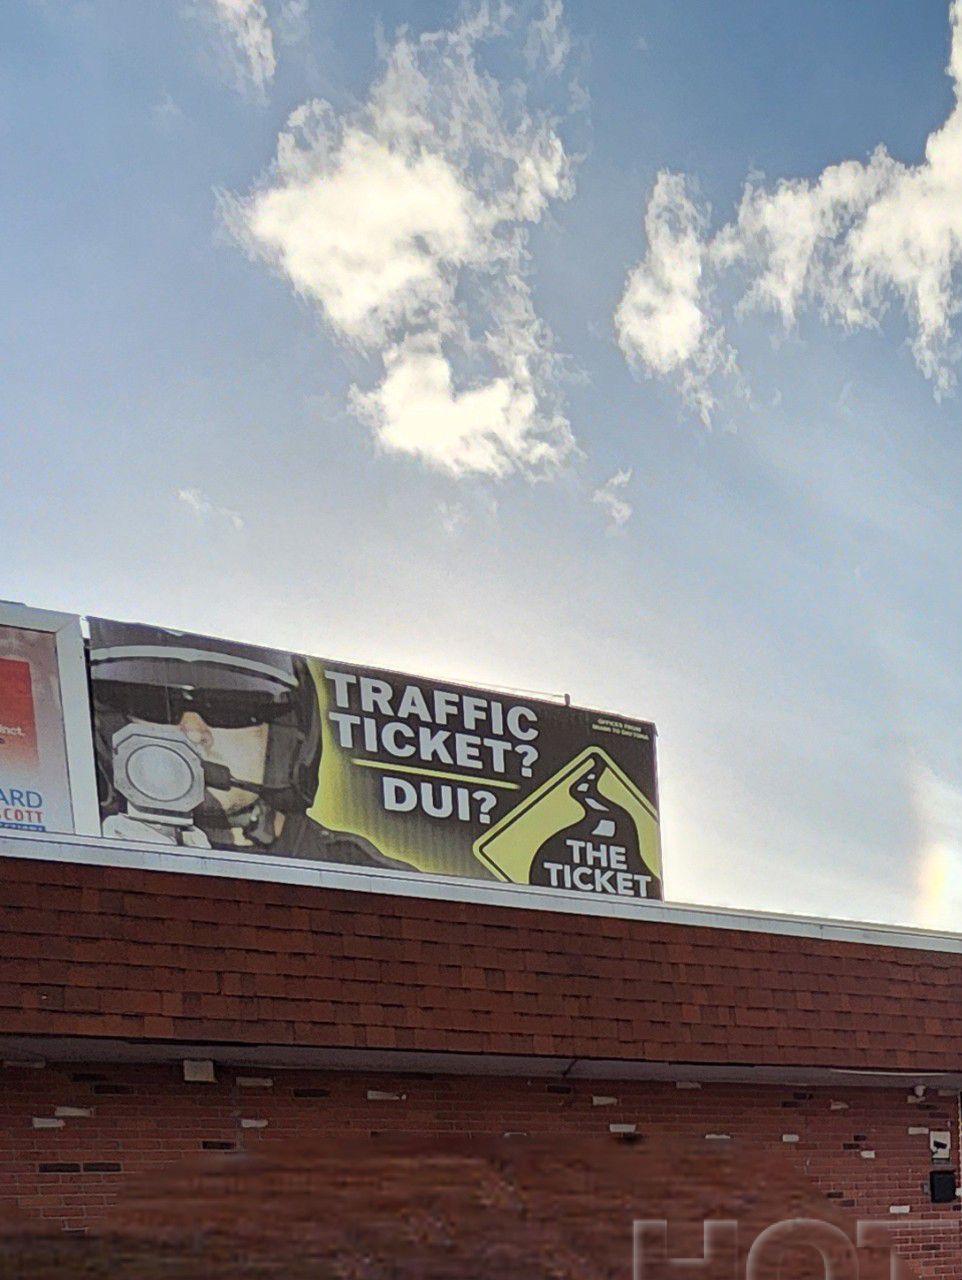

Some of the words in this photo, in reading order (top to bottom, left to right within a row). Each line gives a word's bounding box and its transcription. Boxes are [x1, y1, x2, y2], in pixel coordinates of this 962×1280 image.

[325, 670, 539, 741] TRAFFIC
[329, 711, 539, 778] TICKET?
[0, 808, 44, 823] COTT
[382, 776, 497, 824] DUI?
[566, 839, 628, 870] THE
[543, 862, 652, 897] TICKET
